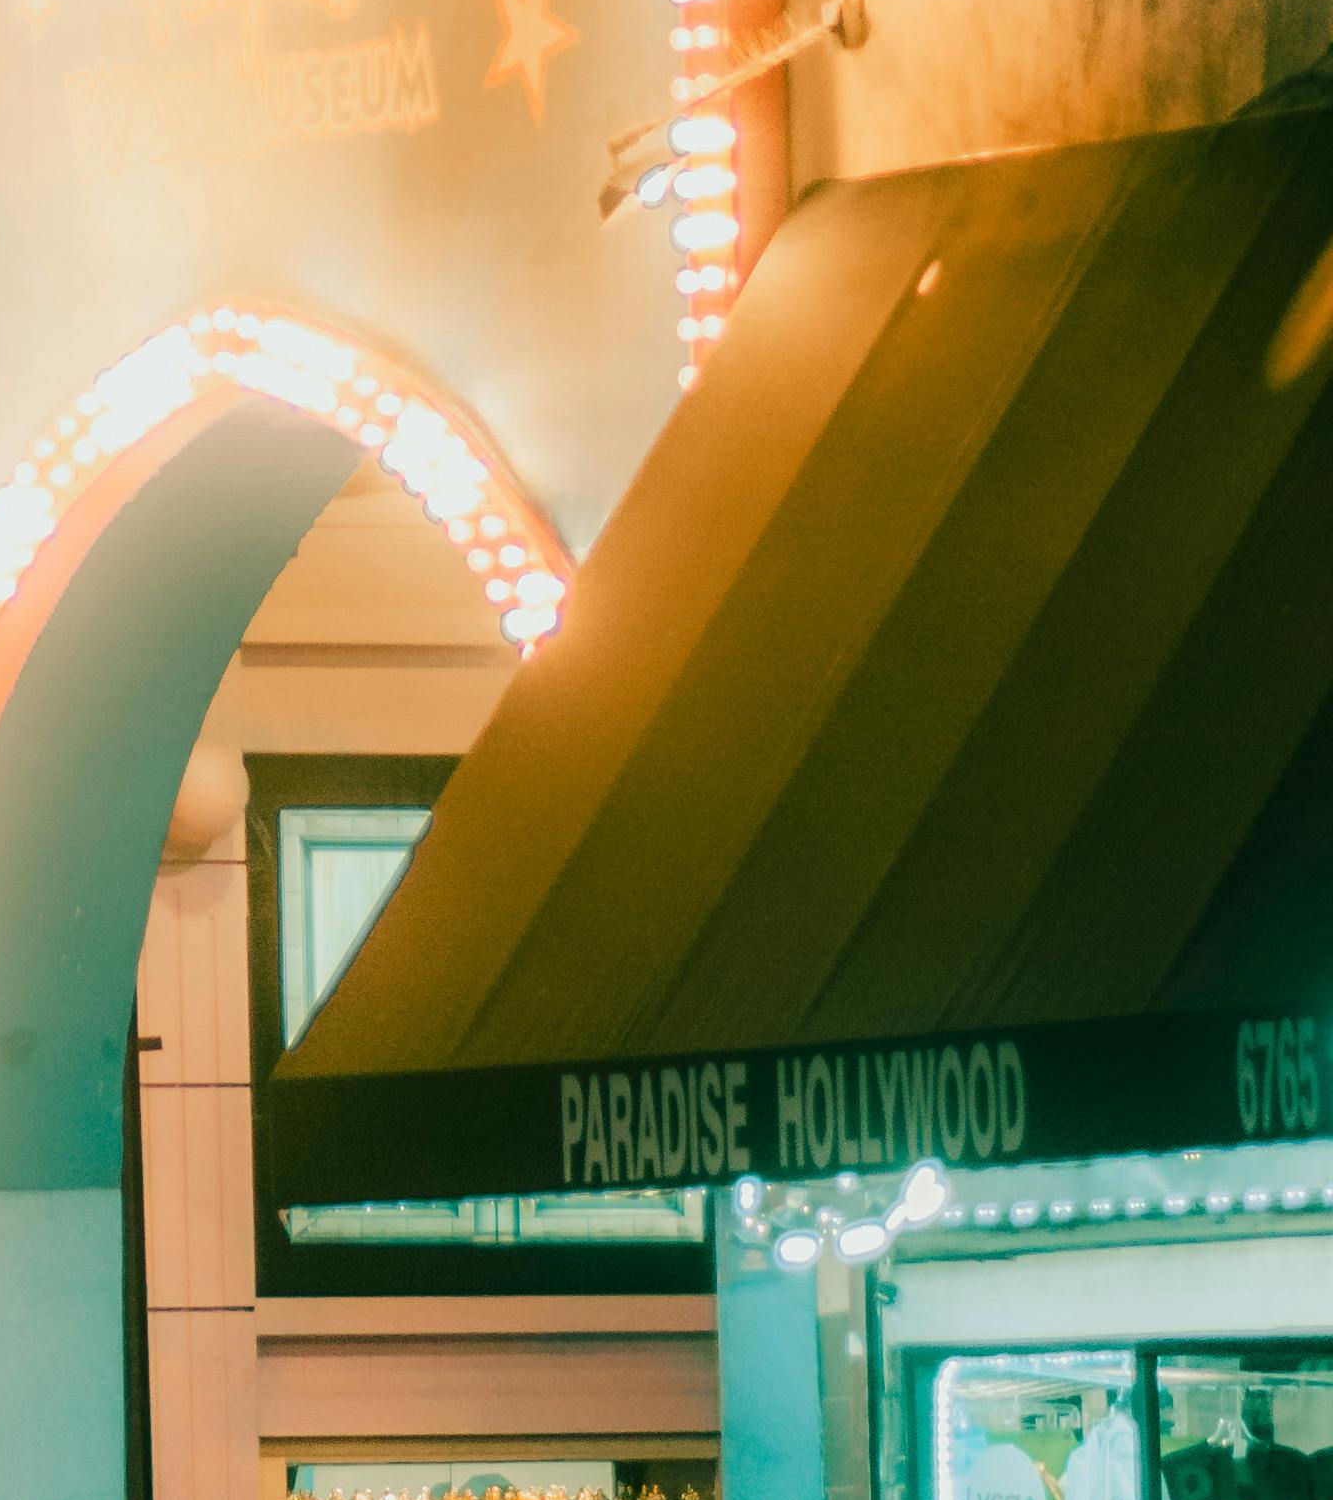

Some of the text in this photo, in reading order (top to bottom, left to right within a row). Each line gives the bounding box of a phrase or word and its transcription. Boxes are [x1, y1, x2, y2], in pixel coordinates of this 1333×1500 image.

[560, 1017, 1319, 1184] PARADISE HOLLYWOOD 6765
